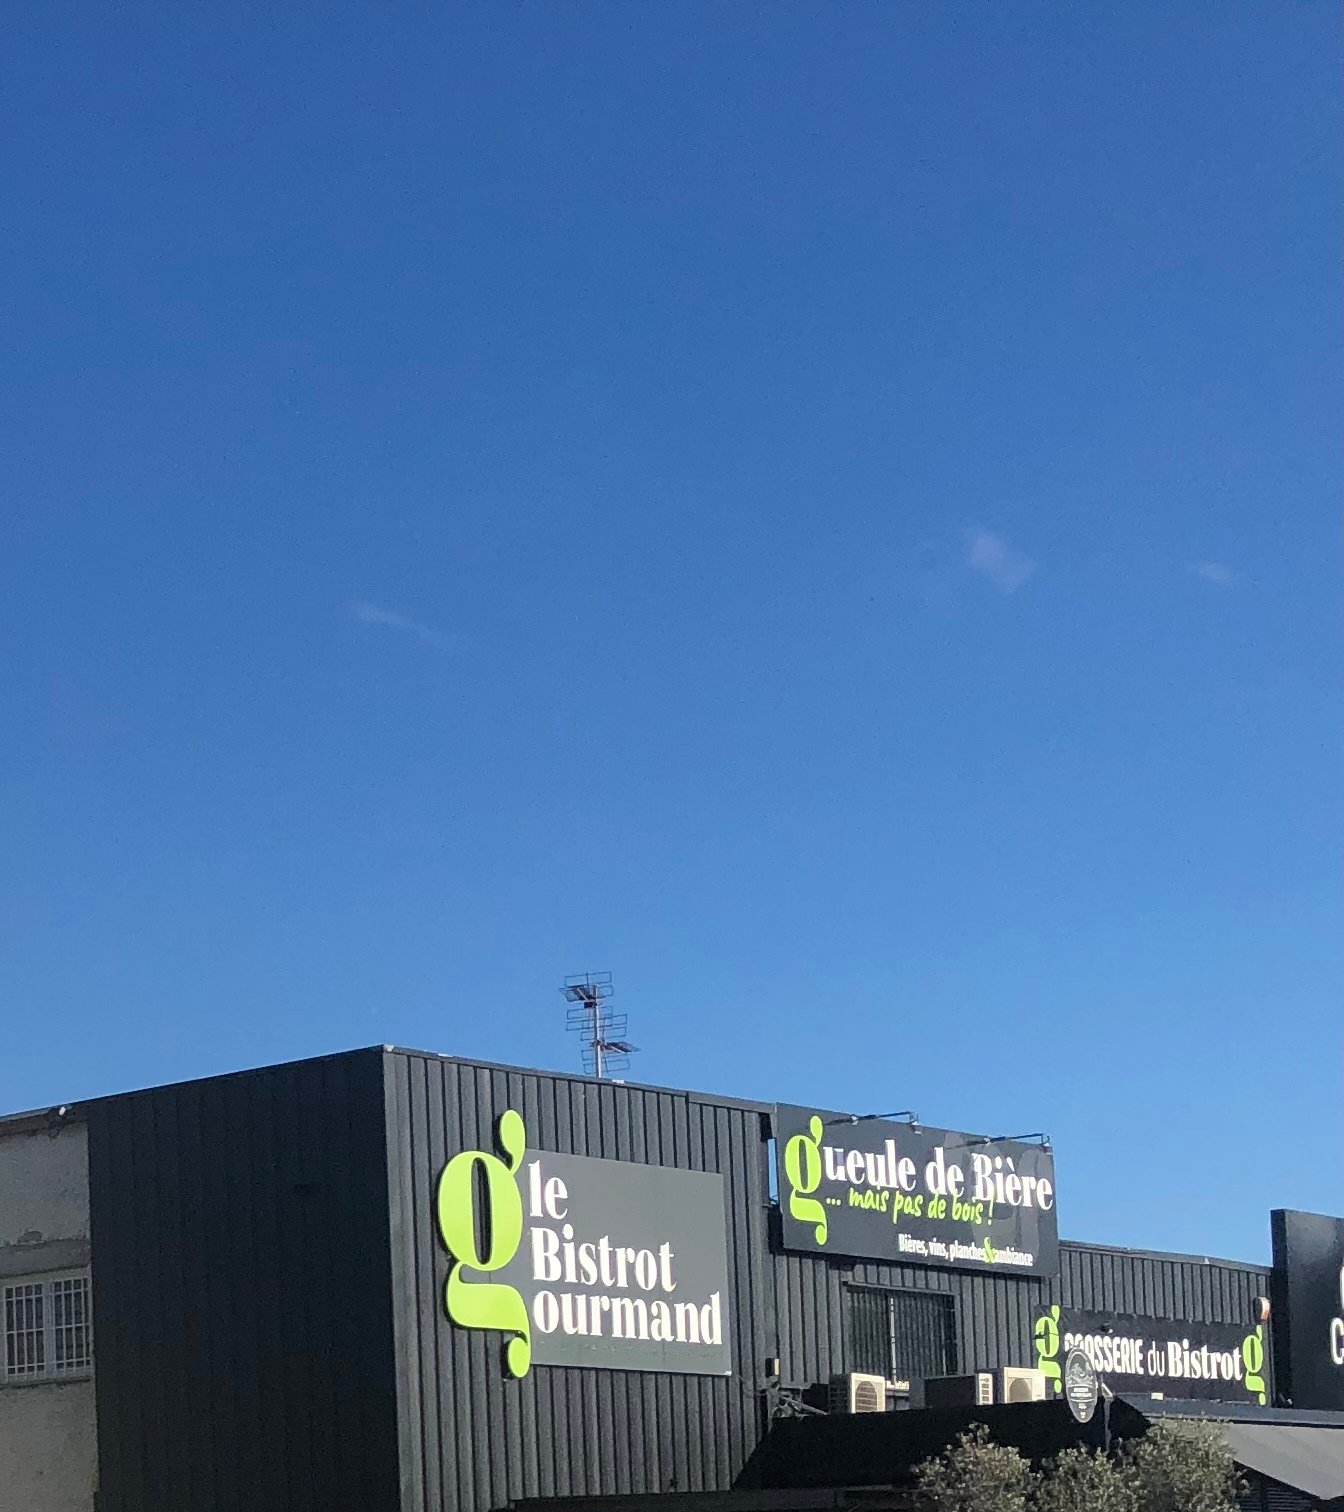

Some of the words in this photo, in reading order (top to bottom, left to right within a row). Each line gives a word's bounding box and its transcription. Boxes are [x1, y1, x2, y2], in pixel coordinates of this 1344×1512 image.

[528, 1160, 569, 1220] le
[849, 1183, 889, 1212] mais
[893, 1191, 922, 1224] pas
[928, 1189, 946, 1219] de
[925, 1147, 964, 1198] de
[971, 1152, 1053, 1210] Bière
[530, 1223, 677, 1292] Bistrot
[1147, 1341, 1166, 1376] du
[1167, 1338, 1243, 1381] Bistrot
